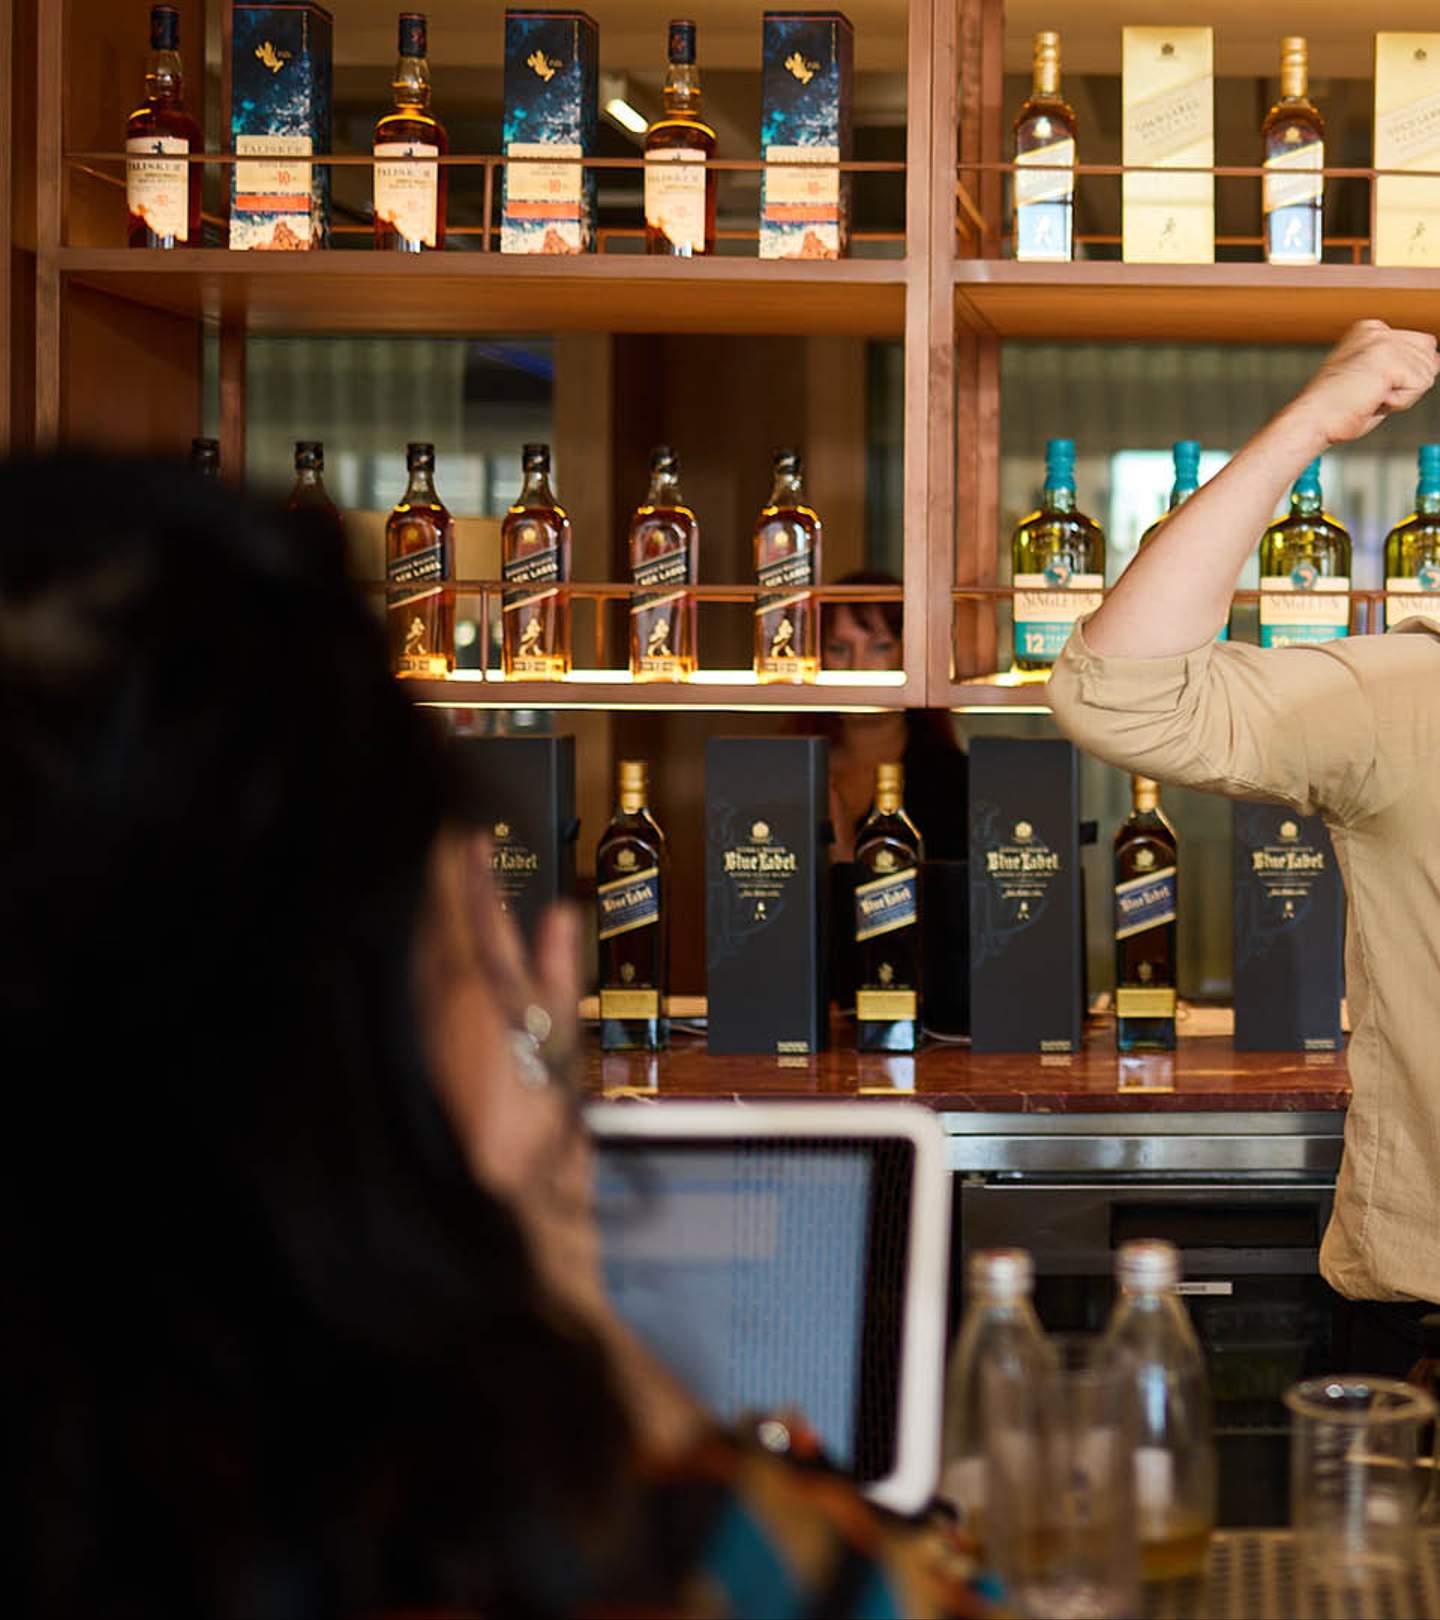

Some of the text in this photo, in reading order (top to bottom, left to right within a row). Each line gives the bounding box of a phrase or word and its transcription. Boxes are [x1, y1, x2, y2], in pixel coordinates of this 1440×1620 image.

[243, 145, 302, 154] TALISKER
[278, 171, 291, 186] 10
[1025, 633, 1045, 653] 12
[724, 852, 758, 871] Blue
[987, 852, 1022, 870] Blue
[1253, 852, 1288, 869] Blue
[602, 886, 653, 913] Blue Label
[861, 886, 912, 914] Blue Label
[1120, 886, 1170, 912] Blue Label
